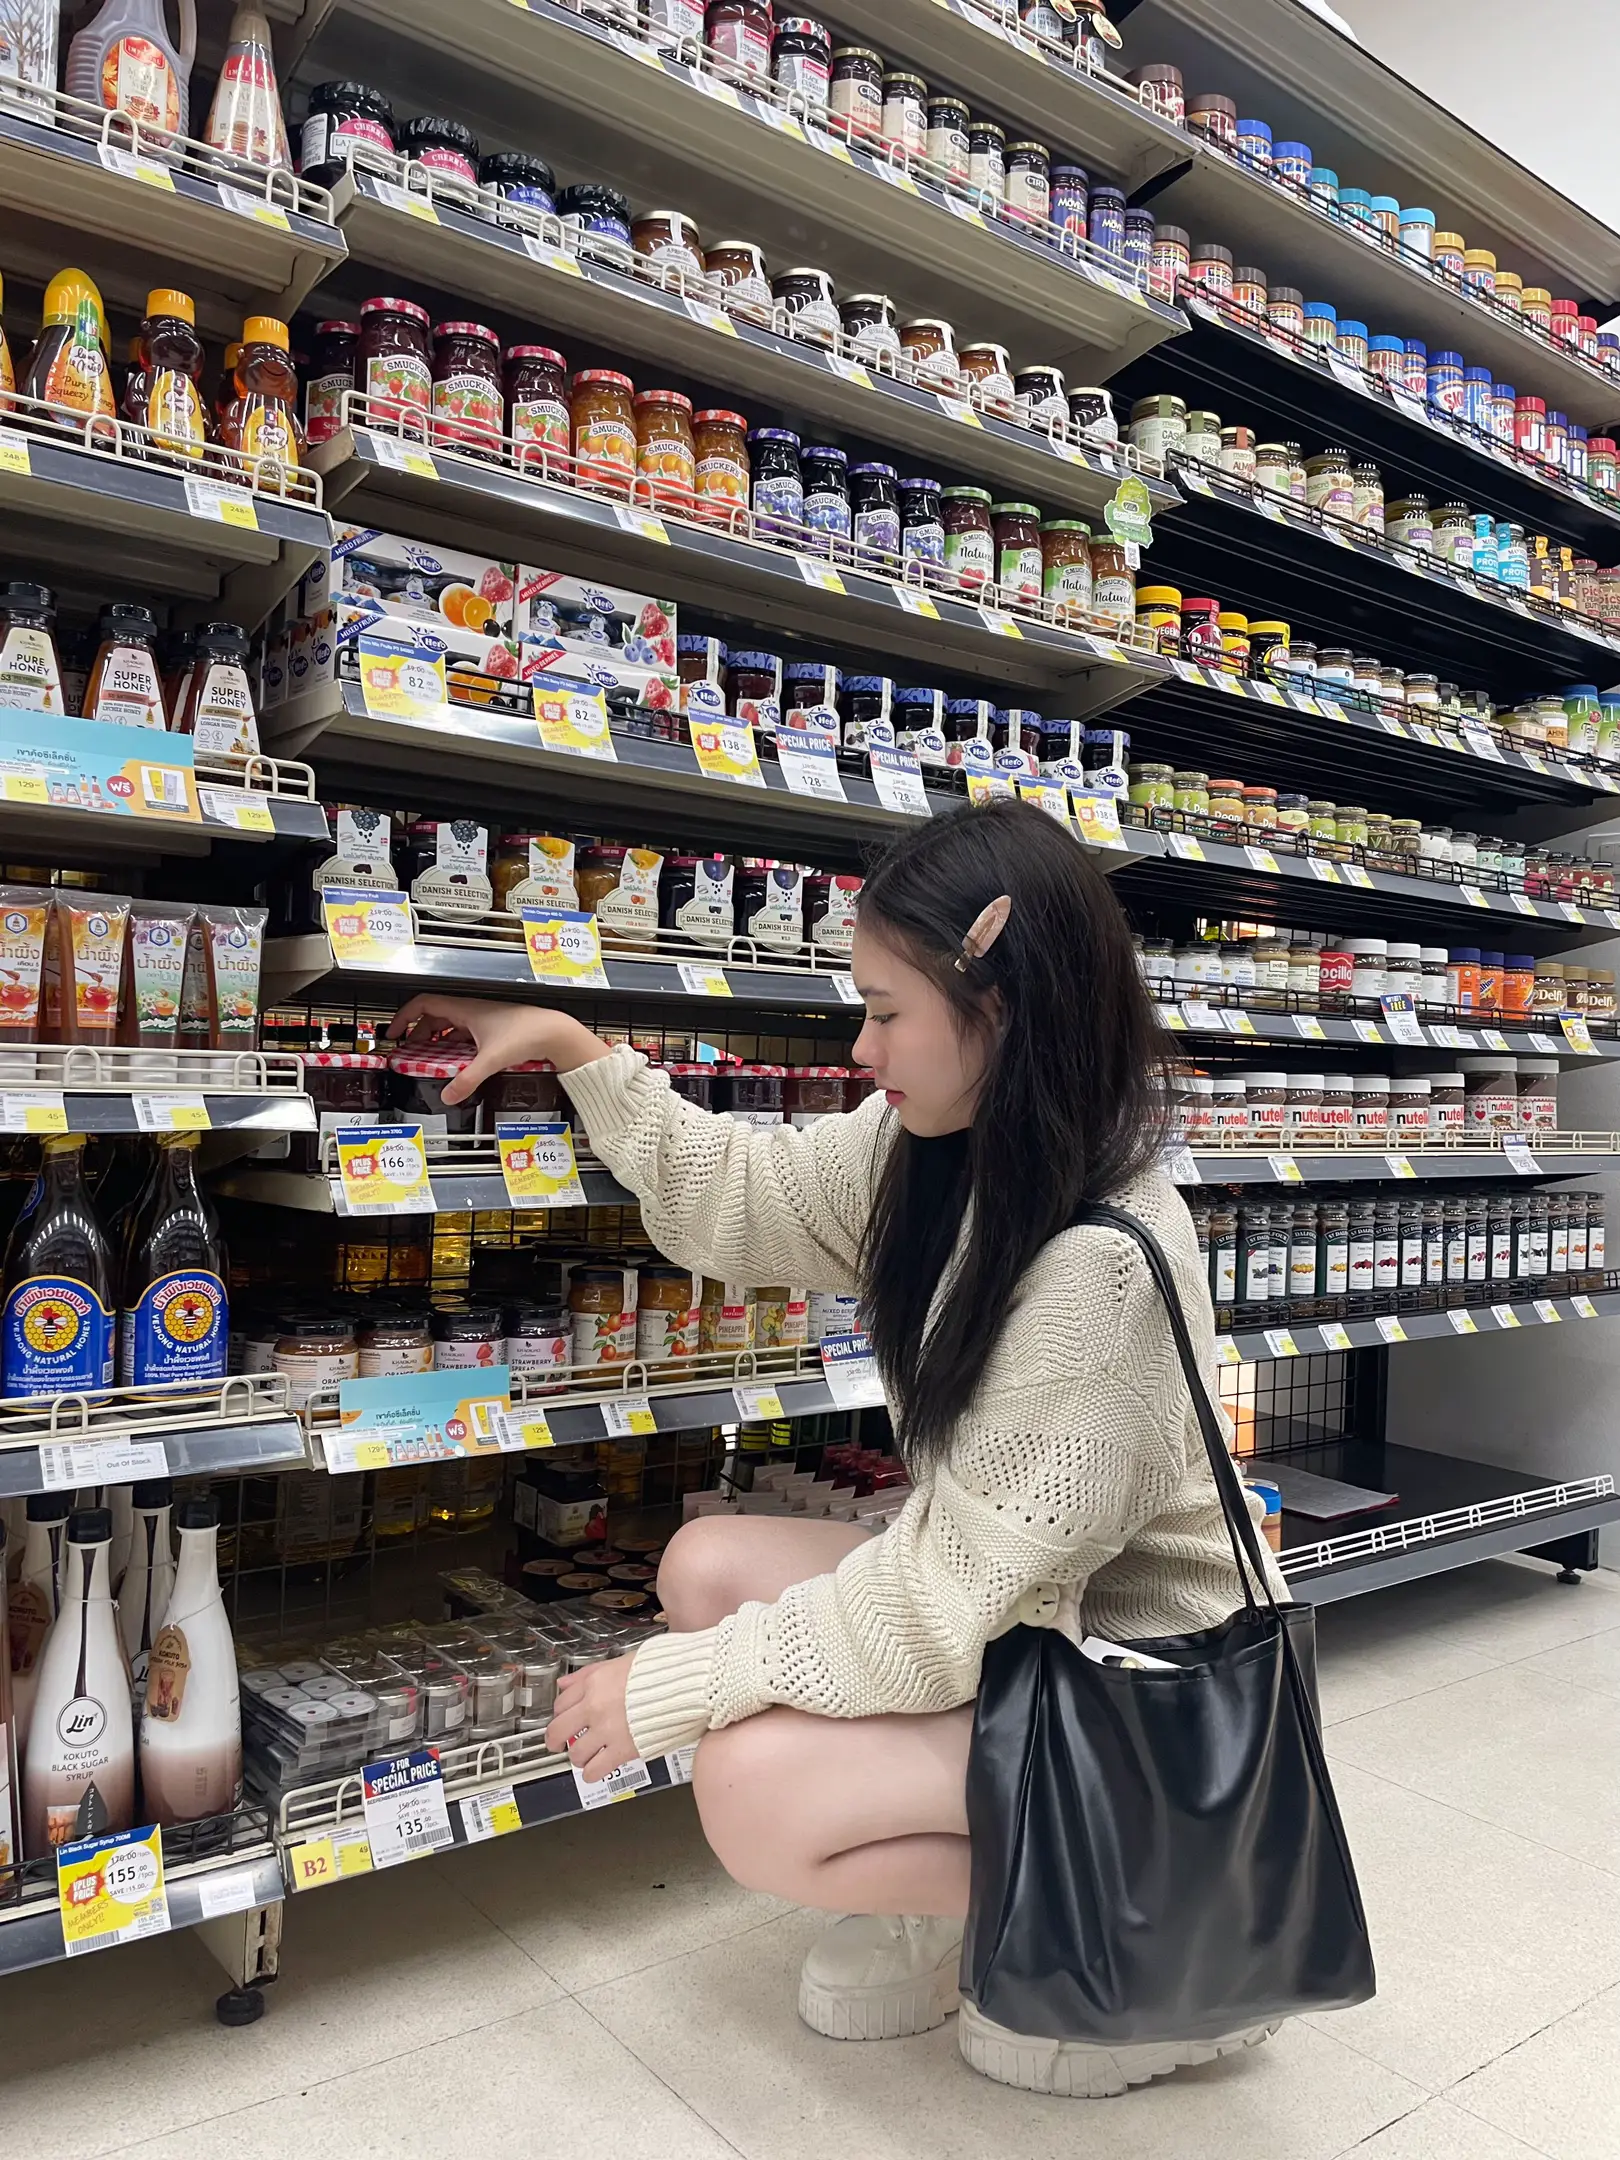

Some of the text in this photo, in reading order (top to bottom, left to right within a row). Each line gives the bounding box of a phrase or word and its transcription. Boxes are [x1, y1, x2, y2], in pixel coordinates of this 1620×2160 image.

[353, 122, 387, 140] CHERRY
[431, 154, 465, 169] CHERRY
[62, 376, 87, 390] Pure
[49, 385, 89, 402] Squeezy
[229, 506, 245, 514] 248
[335, 531, 373, 556] MIXED FRUITS
[418, 558, 443, 571] Hero
[521, 587, 537, 600] MIXED
[1095, 592, 1132, 605] Natural
[593, 598, 614, 611] Hero
[340, 614, 379, 639] MIXED FRUITS
[424, 637, 447, 650] Hero
[16, 653, 45, 666] PURE
[9, 661, 50, 676] HONEY
[114, 670, 152, 685] SUPER
[408, 676, 425, 689] 82
[598, 673, 619, 685] Hero
[113, 680, 152, 694] HONEY
[211, 686, 246, 700] SUPER
[211, 696, 247, 709] HONEY
[700, 692, 721, 703] Hero
[575, 709, 589, 721] 82
[818, 716, 837, 727] Hero
[876, 729, 893, 741] Hero
[721, 739, 740, 751] 138
[777, 733, 832, 752] SPECIAL PRICE
[926, 738, 943, 749] Hero
[871, 748, 920, 769] SPECIAL PRICE
[972, 747, 990, 758] Hero
[1000, 757, 1023, 767] Hero
[1063, 767, 1080, 778] Hero
[18, 779, 35, 789] 129
[801, 775, 822, 787] 128
[1106, 775, 1124, 787] Hero
[892, 789, 911, 803] 128
[1043, 799, 1057, 810] 128
[247, 811, 261, 819] 129
[1095, 809, 1109, 819] 138
[324, 876, 395, 890] DANISH SELECTION
[421, 884, 489, 900] DANISH SELECTION
[516, 897, 577, 910] DANISH SELECTION
[607, 905, 632, 916] DANISH
[368, 919, 392, 932] 209
[686, 915, 710, 924] DANISH
[758, 923, 780, 931] DANISH
[821, 928, 841, 936] DANISH
[560, 937, 580, 948] 209
[76, 943, 120, 962] น้ำผึ้ง
[137, 953, 182, 971] น้ำผึ้ง
[217, 955, 259, 972] น้ำผึ้ง
[1390, 1000, 1406, 1011] FREE
[1491, 1101, 1514, 1112] nutella
[1536, 1104, 1555, 1113] nutella
[47, 1112, 60, 1121] 45
[380, 1156, 405, 1169] 166
[536, 1151, 557, 1162] 166
[151, 1310, 222, 1354] VEJPONG NATURAL HONEY
[718, 1325, 746, 1333] PINEAPPLE
[13, 1320, 91, 1365] VEJPONG NATURAL HONEY
[823, 1341, 853, 1358] SPECIAL
[511, 1358, 552, 1366] STRAWBERRY
[367, 1445, 381, 1453] 129
[107, 1457, 152, 1469] Out Of Stock
[158, 1650, 180, 1660] KOKUTO
[66, 1713, 94, 1734] Lin
[63, 1749, 99, 1761] KOKUTO
[52, 1756, 109, 1772] BLACK SUGAR
[390, 1757, 411, 1773] 2 FOR
[66, 1771, 94, 1782] SYRUP
[371, 1760, 438, 1794] SPECIAL PRICE
[398, 1812, 410, 1820] SAVE
[396, 1817, 423, 1838] 135
[59, 1838, 115, 1856] Lin Black Sugar Syrup
[359, 1845, 369, 1853] 49
[303, 1856, 327, 1878] B2
[108, 1864, 148, 1885] 155 .00
[72, 1875, 97, 1890] VPLUS
[73, 1886, 96, 1901] PRICE
[110, 1887, 125, 1896] SAVE
[67, 1899, 109, 1929] MEMBERS
